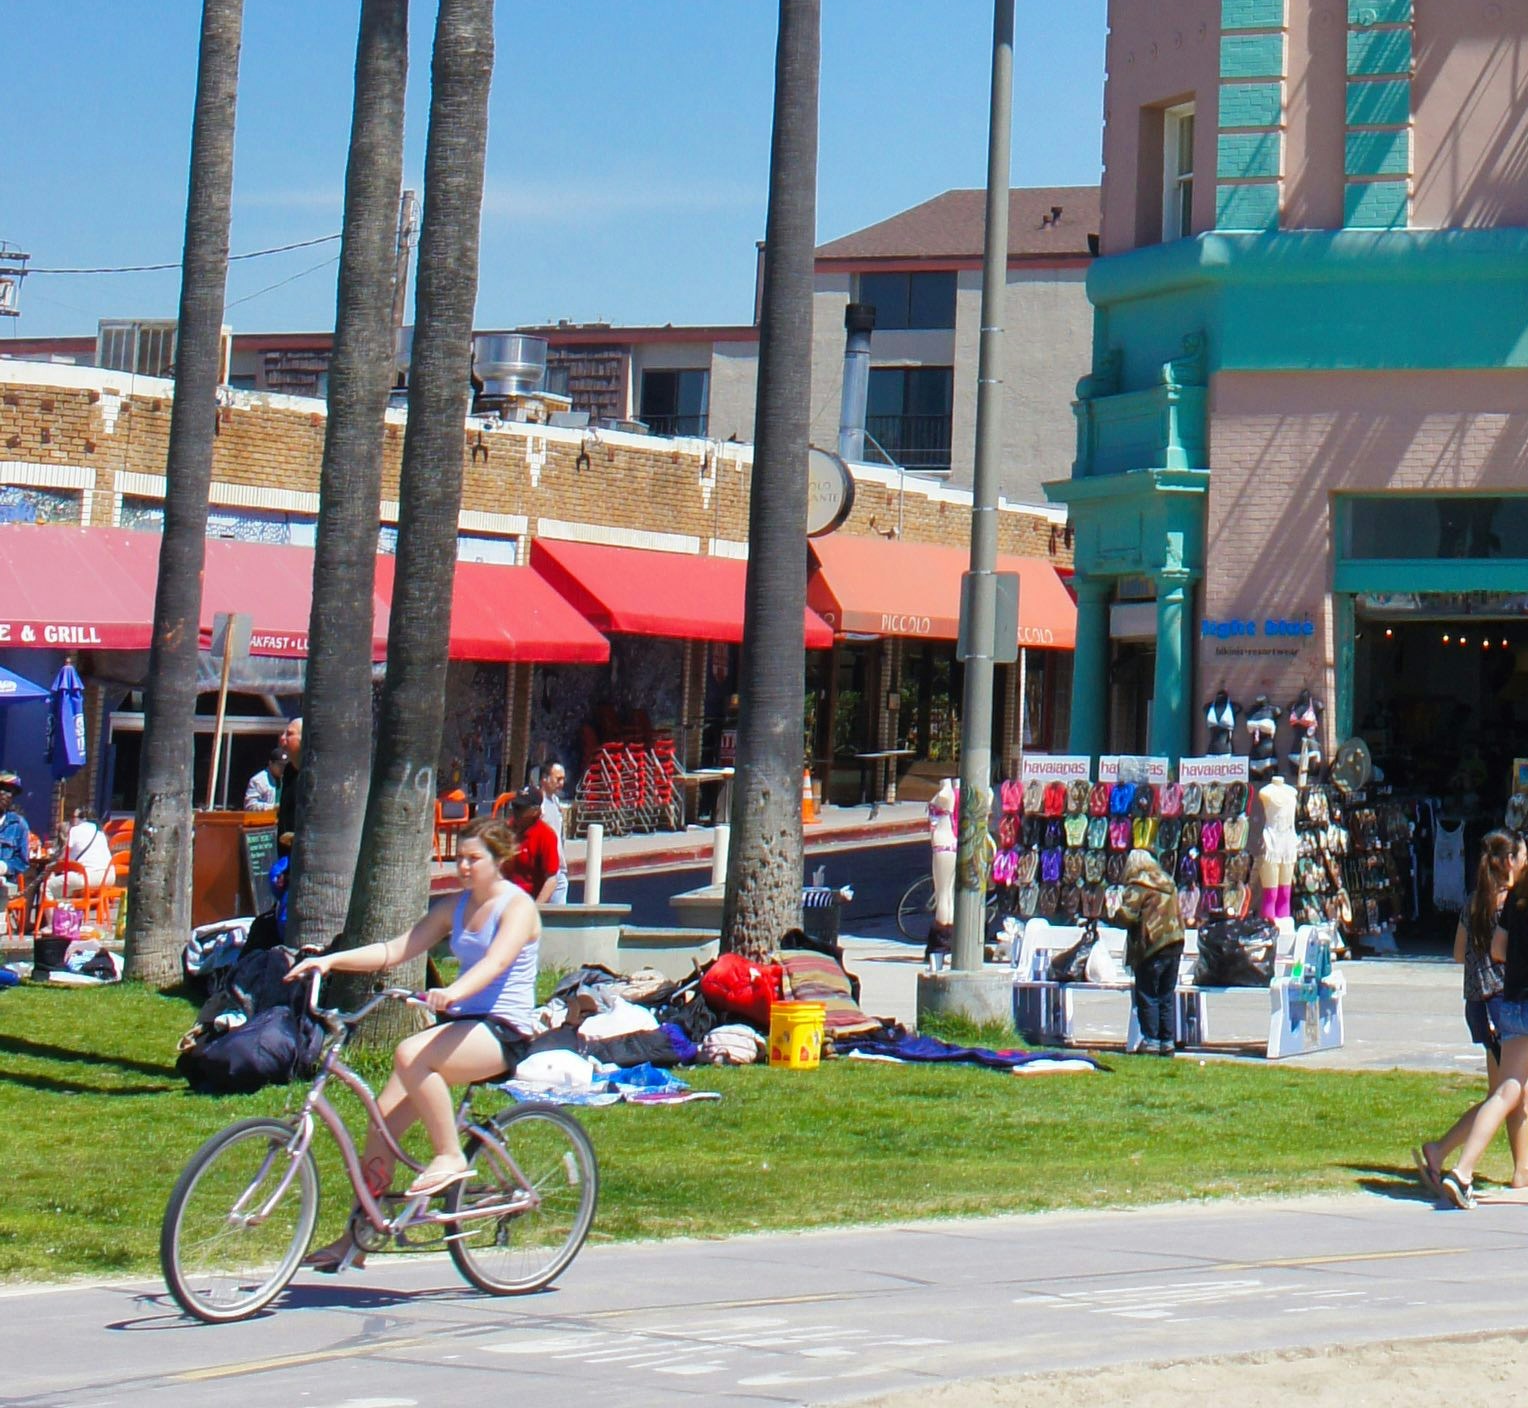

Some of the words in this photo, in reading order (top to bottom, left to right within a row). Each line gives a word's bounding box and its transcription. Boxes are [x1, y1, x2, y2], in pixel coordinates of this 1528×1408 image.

[20, 624, 36, 642] &
[44, 624, 101, 644] GRILL
[881, 614, 931, 634] PICCOLO
[1263, 617, 1315, 637] blue
[249, 635, 289, 649] AKFAST
[1017, 626, 1054, 644] CCOLO
